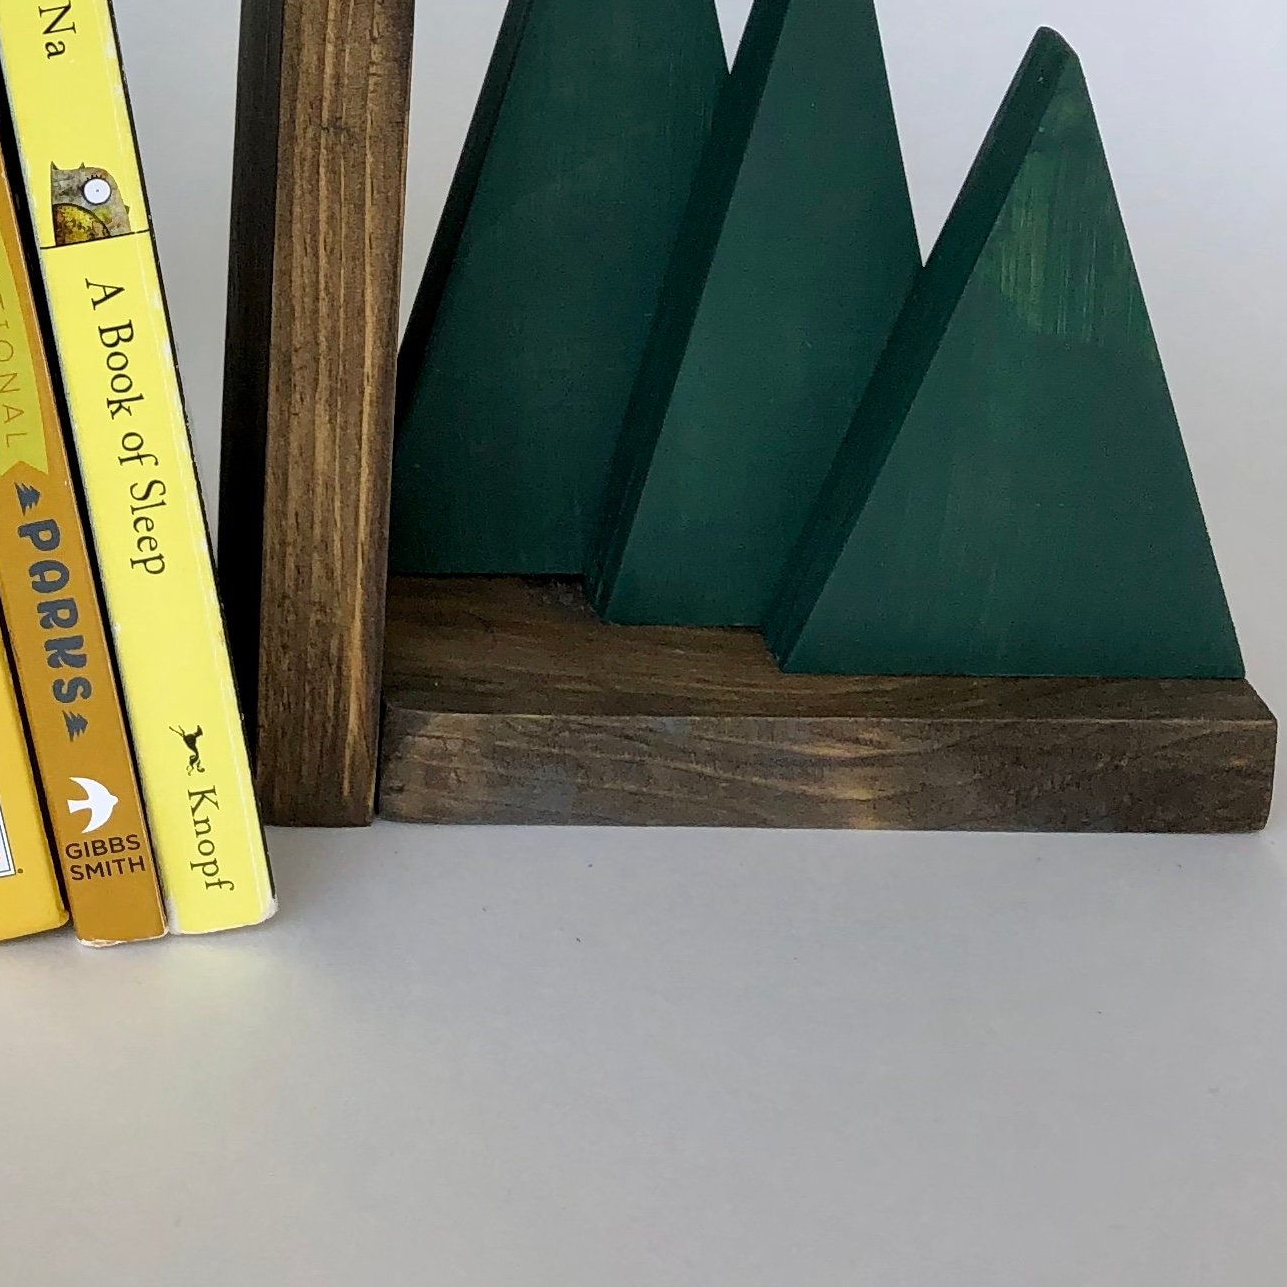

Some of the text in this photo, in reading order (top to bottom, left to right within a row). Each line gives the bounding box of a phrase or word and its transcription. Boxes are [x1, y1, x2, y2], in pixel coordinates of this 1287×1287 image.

[37, 0, 77, 60] Na
[85, 277, 167, 576] A Book of Sleep
[17, 518, 92, 704] PARKS
[65, 833, 141, 860] GIBBS
[69, 855, 146, 881] SMITH
[187, 784, 235, 893] Knopf
